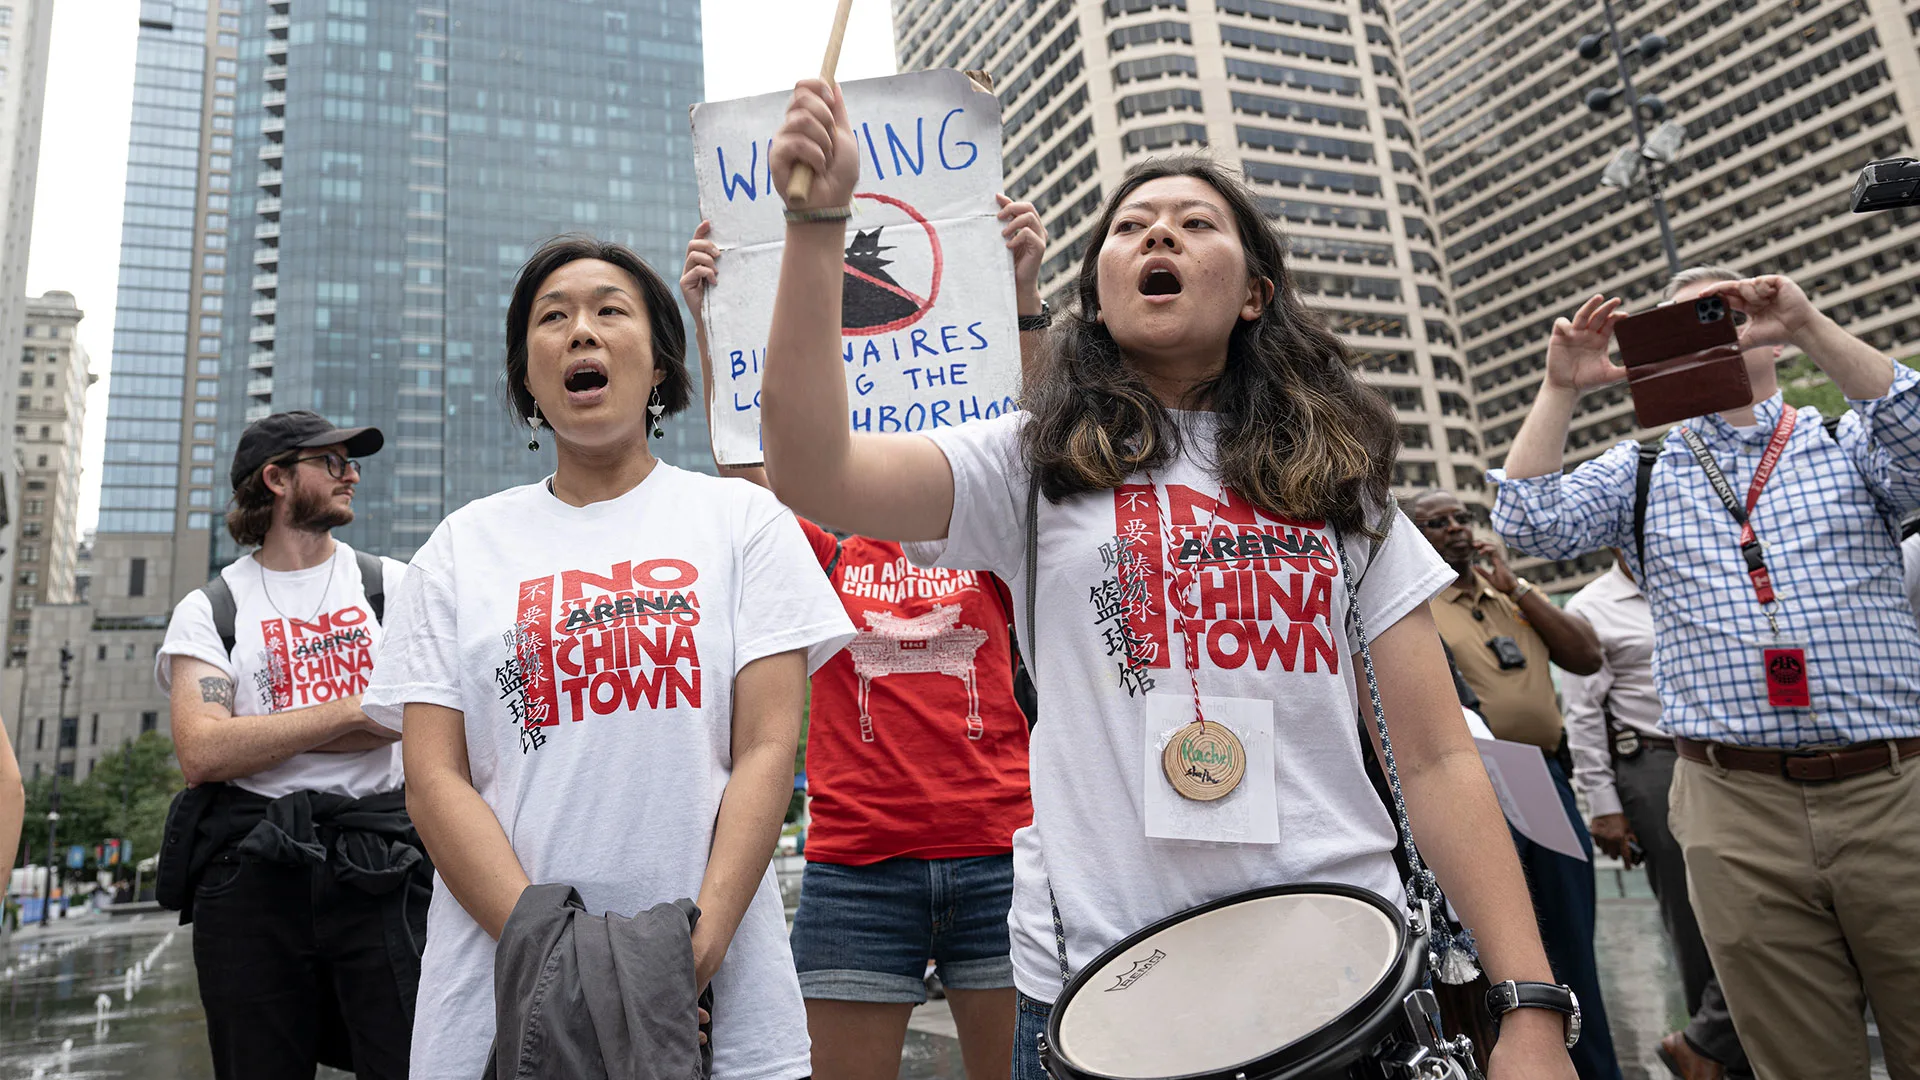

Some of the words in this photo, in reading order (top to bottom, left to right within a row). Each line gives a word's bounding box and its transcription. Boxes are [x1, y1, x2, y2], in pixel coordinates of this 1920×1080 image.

[716, 107, 978, 202] WING
[730, 321, 988, 381] BINAIRES
[902, 363, 968, 390] THE
[1700, 453, 1738, 509] UNIVERSITY
[1757, 440, 1782, 484] TEMPLE
[1178, 534, 1330, 560] ARENA
[561, 558, 699, 602] NO
[841, 569, 980, 604] CHINATOWN!
[844, 563, 875, 584] NO
[881, 556, 951, 583] ARENA
[565, 594, 693, 632] ARENA
[1168, 569, 1333, 627] CHINA
[289, 605, 368, 638] NO
[296, 628, 366, 655] ARENA
[556, 625, 701, 677] CHINA
[1174, 618, 1339, 675] TOWN
[293, 648, 374, 683] CHINA
[561, 666, 702, 722] TOWN
[1181, 738, 1233, 768] Rachel
[1119, 955, 1162, 987] REMO
